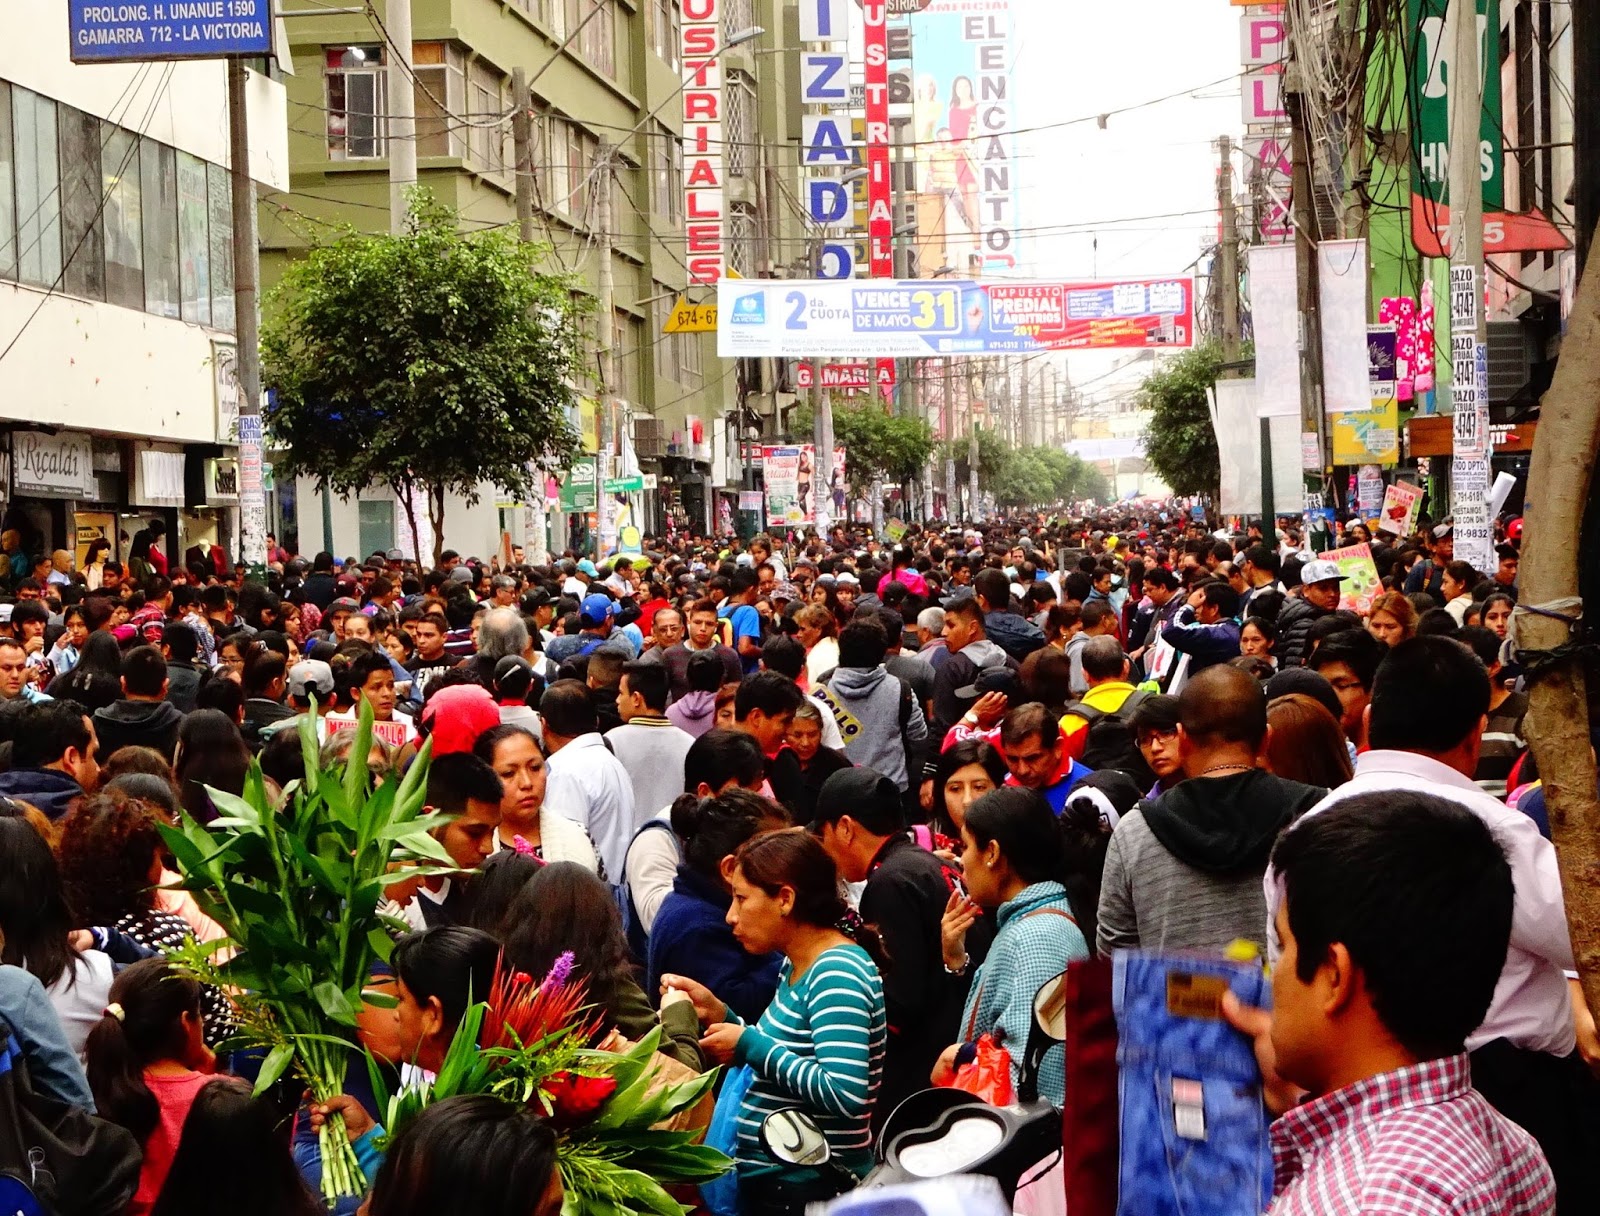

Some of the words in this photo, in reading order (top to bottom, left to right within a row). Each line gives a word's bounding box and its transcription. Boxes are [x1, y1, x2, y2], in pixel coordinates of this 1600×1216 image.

[83, 6, 151, 23] PROLONG.
[154, 4, 167, 20] H.
[170, 2, 224, 19] UNANUE
[227, 0, 256, 17] 1590
[78, 27, 145, 46] GAMARRA
[150, 26, 172, 42] 712
[182, 24, 200, 41] LA
[201, 21, 264, 40] VICTORIA
[965, 16, 1007, 40] EL
[1420, 140, 1494, 183] HNS
[991, 288, 1061, 298] IMPUESTO
[810, 308, 850, 320] CUOTA
[854, 292, 911, 308] VENCE
[911, 290, 957, 329] 31
[992, 298, 1062, 313] PREDIAL
[856, 314, 878, 328] DE
[879, 314, 911, 328] MAYO
[992, 313, 1000, 324] Y
[1003, 312, 1062, 325] ARBITRIOS
[1012, 325, 1041, 337] 2017
[21, 432, 80, 481] Ricaldi
